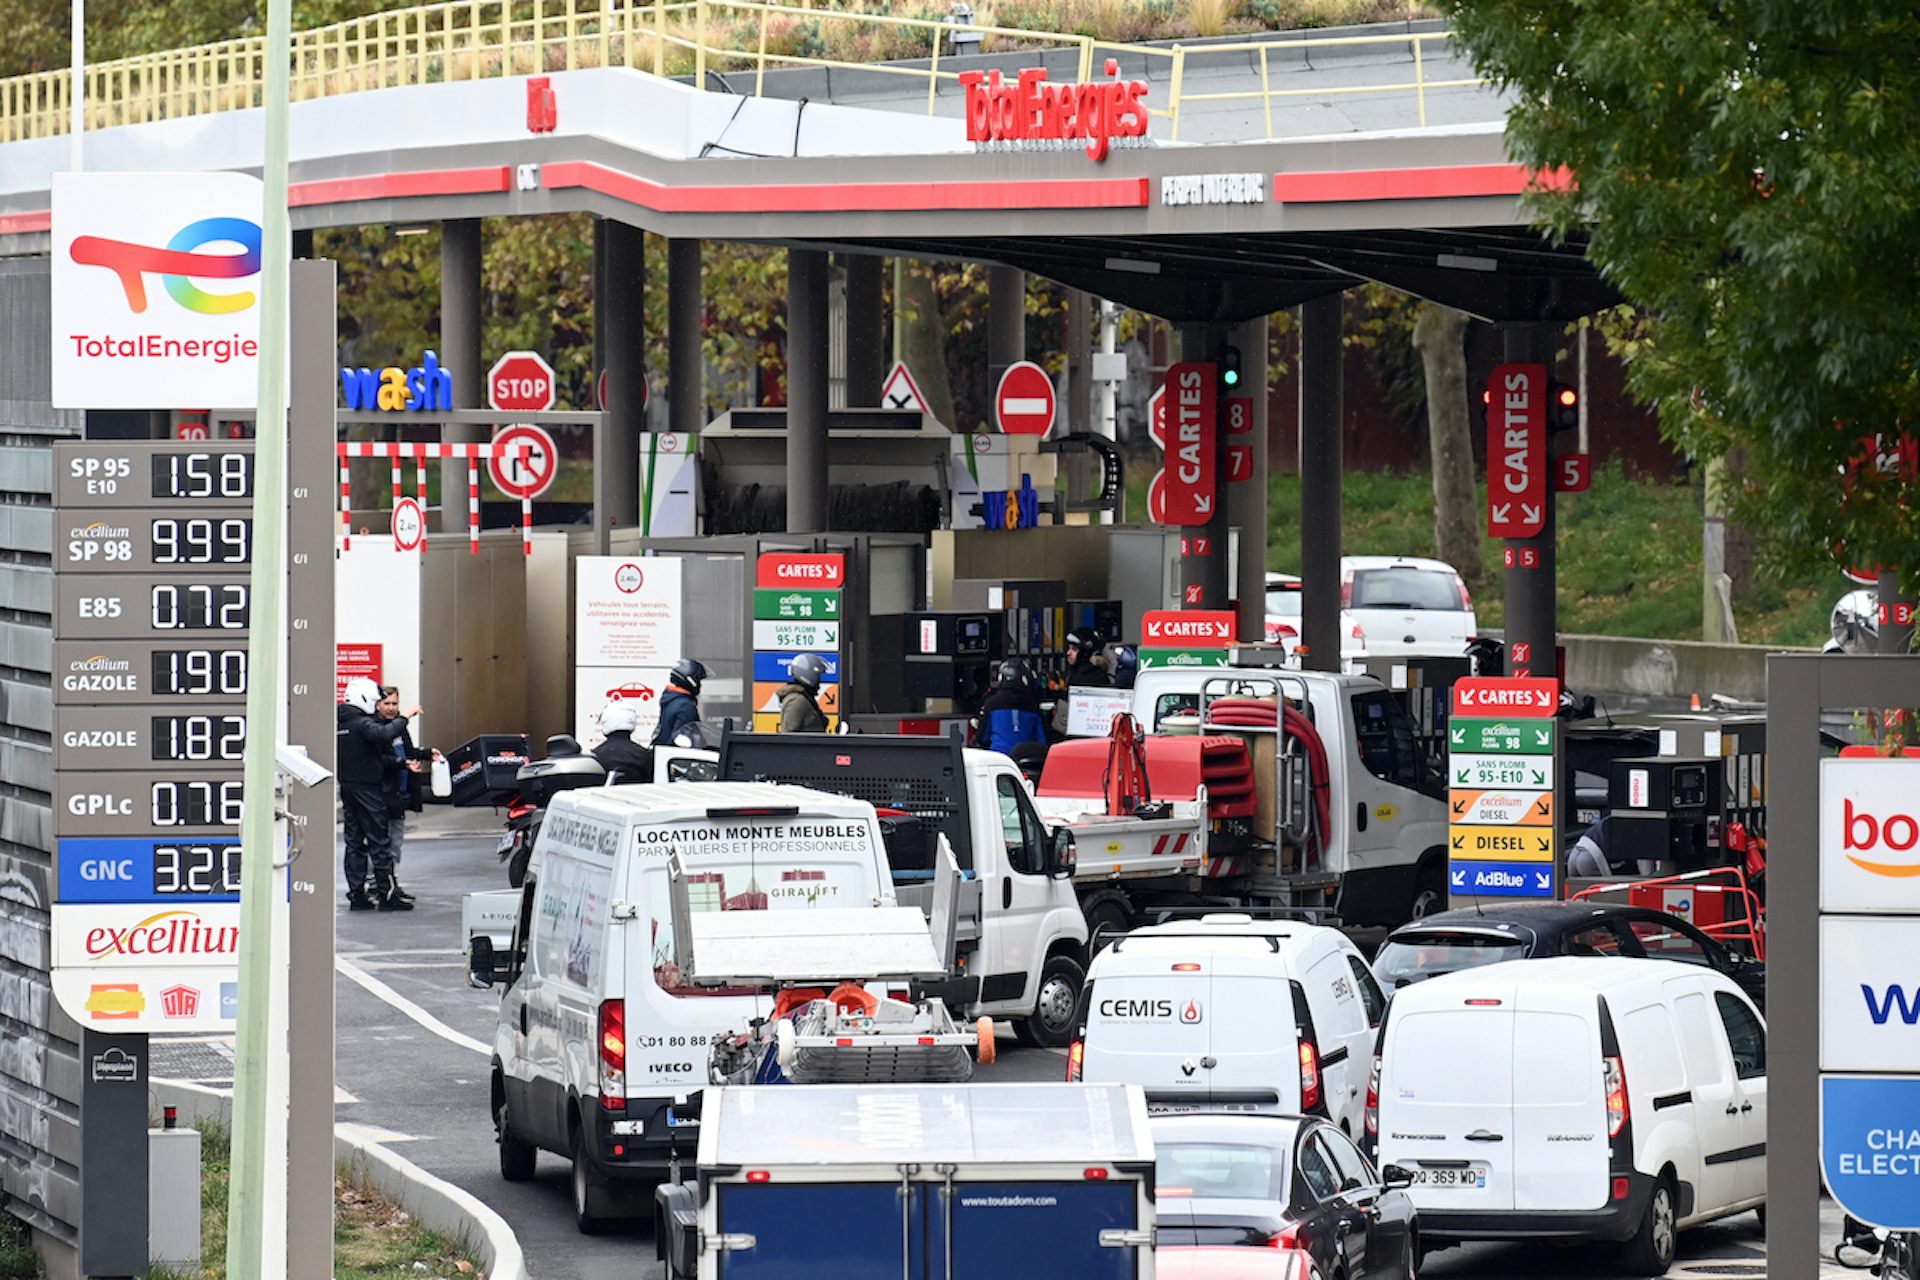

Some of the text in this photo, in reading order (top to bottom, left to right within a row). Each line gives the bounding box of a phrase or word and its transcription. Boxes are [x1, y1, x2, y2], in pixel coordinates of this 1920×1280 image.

[959, 58, 1149, 161] TotalEnergies
[70, 334, 258, 363] TotalEnergie
[341, 350, 452, 411] wash
[496, 378, 547, 399] STOP
[1230, 404, 1243, 428] 8
[1178, 371, 1202, 485] CARTES
[1504, 372, 1529, 493] CARTES
[1230, 451, 1243, 476] 7
[71, 453, 246, 497] SP 95 1.58
[1564, 460, 1580, 486] 5
[87, 480, 117, 495] E10
[70, 524, 130, 539] excellium
[69, 519, 246, 563] SP 98 9.99
[1524, 552, 1534, 564] 5
[777, 563, 824, 578] CARTES
[79, 585, 246, 629] E85 0.72
[799, 605, 813, 617] 98
[1899, 607, 1908, 621] 3
[1164, 622, 1213, 636] CARTES
[63, 651, 245, 694] GAZOLE 1.90
[70, 657, 130, 671] excellium
[1478, 690, 1533, 705] CARTES
[63, 716, 246, 760] GAZOLE 1.82
[1505, 736, 1521, 750] 98
[1476, 760, 1526, 769] SANS PLOMB
[68, 781, 244, 826] GPLc 0.76
[1480, 809, 1509, 820] DIESEL
[1843, 798, 1920, 851] bo
[637, 825, 866, 844] LOCATION MONTE MEUBLES
[1476, 836, 1525, 851] DIESEL
[637, 840, 867, 857] PARTULIERS ET PROFESSIONNELS
[79, 859, 134, 881] GNC
[1475, 870, 1525, 887] AdBlue
[771, 884, 839, 897] GIRALIFT
[1100, 999, 1172, 1017] CEMIS
[648, 1036, 706, 1047] 01 80 88
[649, 1063, 693, 1073] IVECO
[1867, 1128, 1920, 1150] CHA
[1840, 1153, 1920, 1175] ELECT
[961, 1195, 1057, 1207] www.toutadom.com
